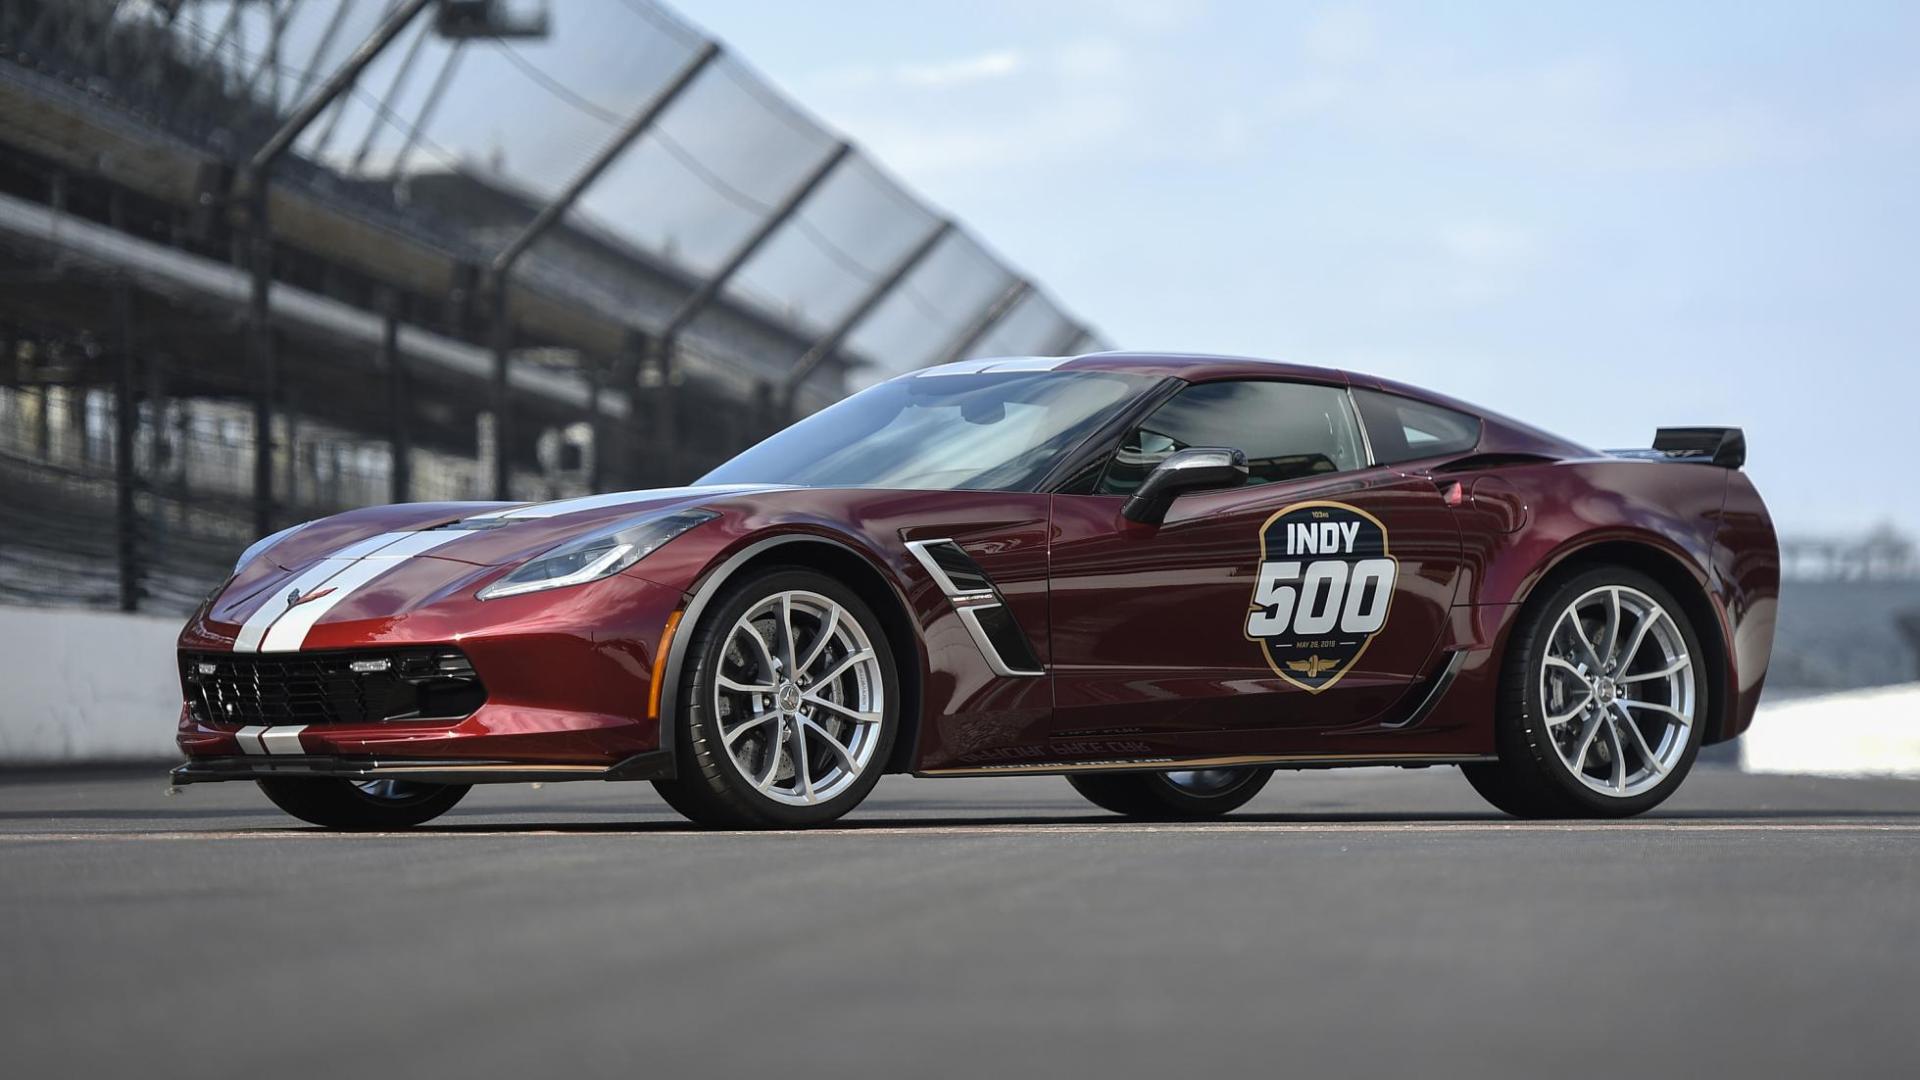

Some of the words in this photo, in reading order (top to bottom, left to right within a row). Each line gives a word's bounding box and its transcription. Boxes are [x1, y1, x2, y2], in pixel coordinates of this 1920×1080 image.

[1286, 521, 1361, 555] INDY
[1247, 559, 1396, 636] 500
[1296, 641, 1309, 649] MAY
